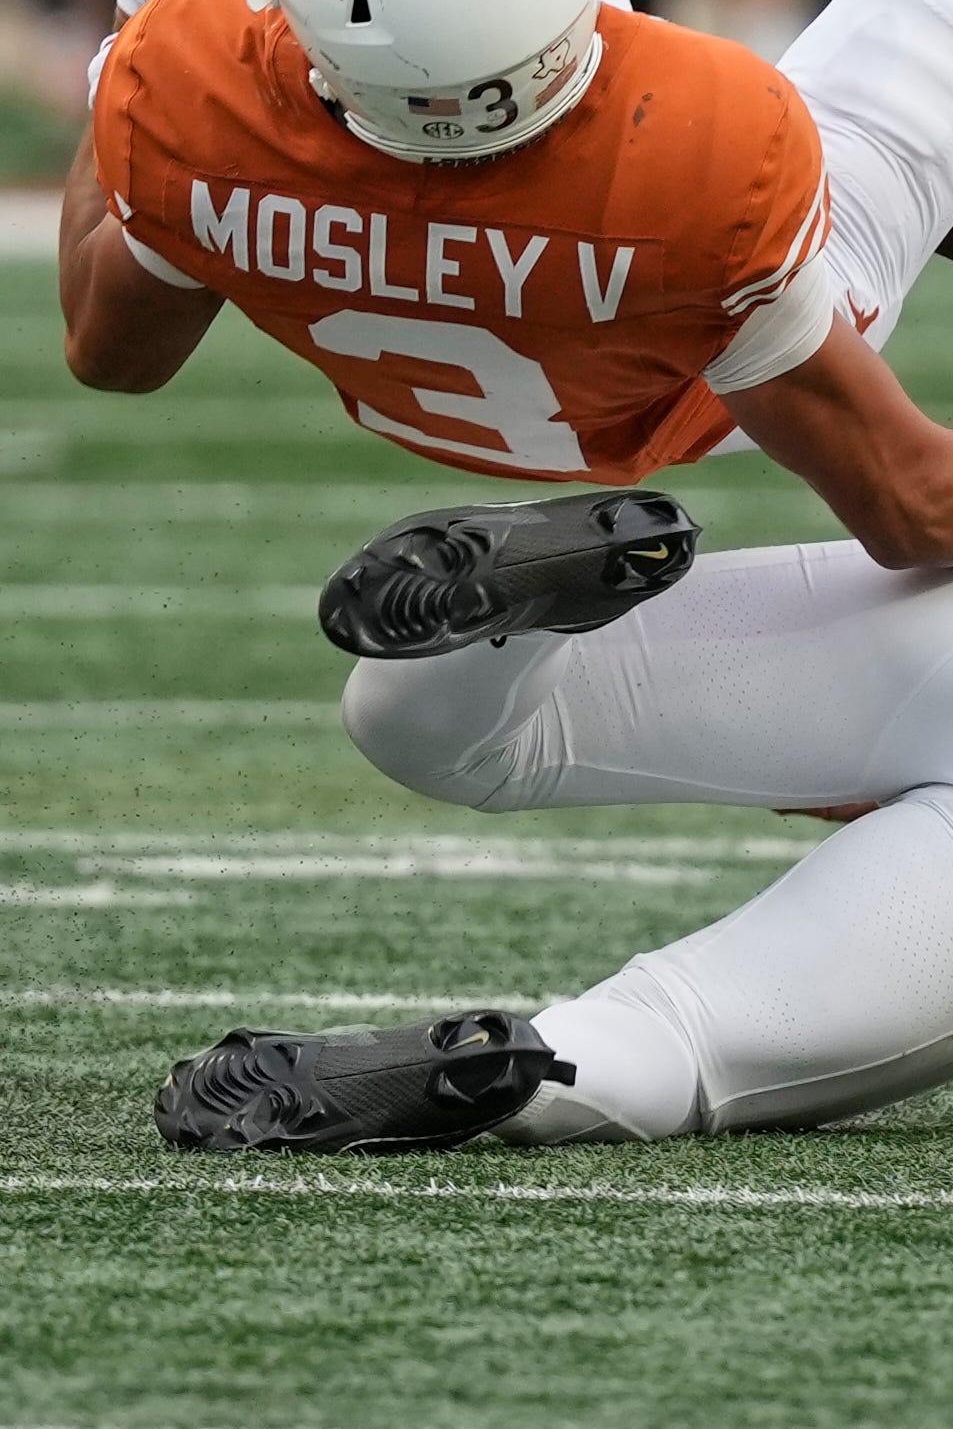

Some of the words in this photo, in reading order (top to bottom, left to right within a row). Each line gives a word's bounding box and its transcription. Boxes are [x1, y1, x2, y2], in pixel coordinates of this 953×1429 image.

[468, 79, 519, 133] 3
[190, 179, 549, 319] MOSLEY
[577, 241, 636, 323] V
[307, 308, 592, 472] 3
